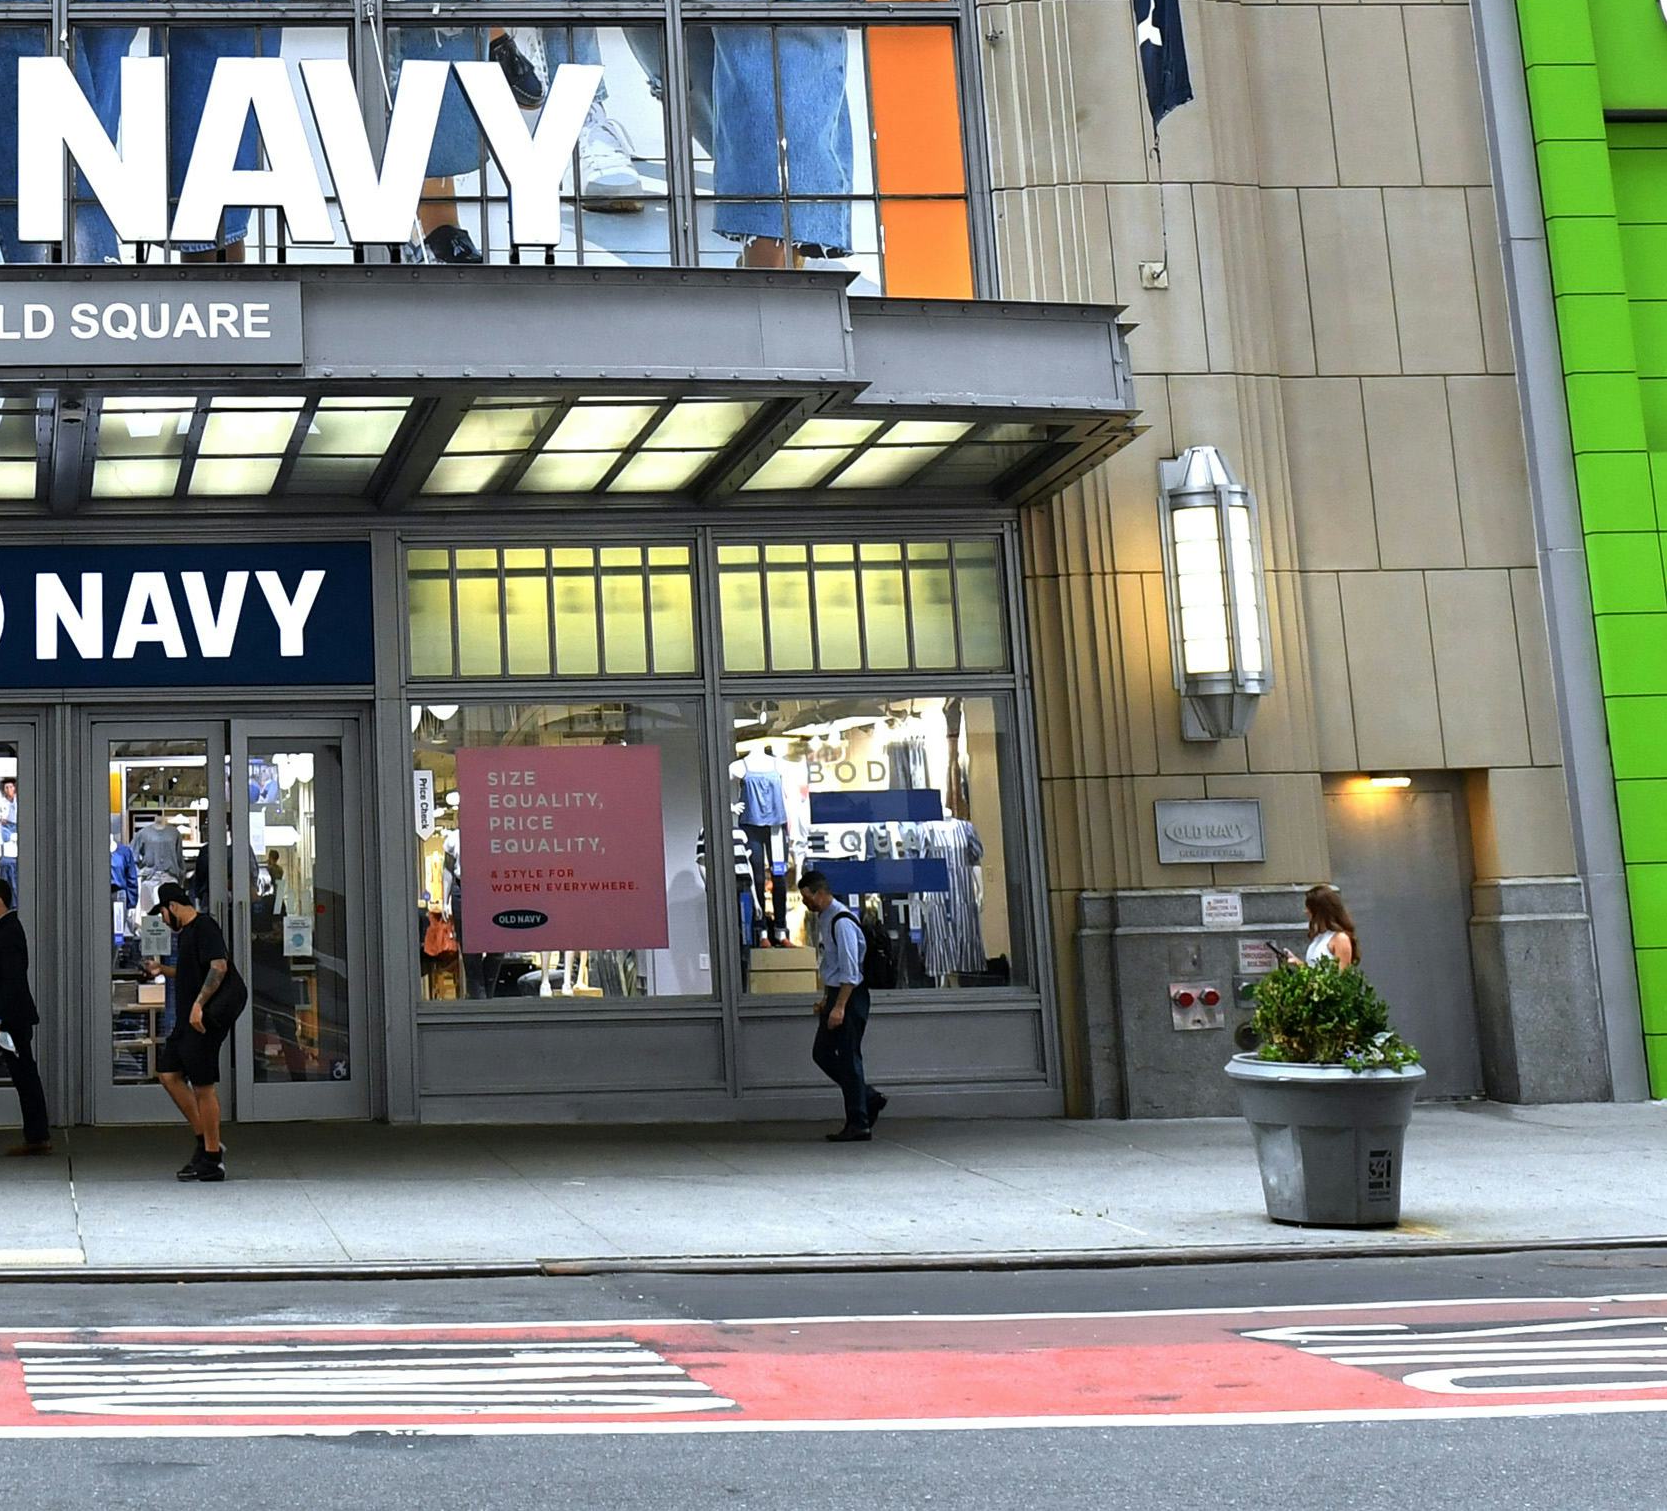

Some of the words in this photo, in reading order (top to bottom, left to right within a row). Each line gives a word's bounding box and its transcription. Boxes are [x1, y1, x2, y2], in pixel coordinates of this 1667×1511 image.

[18, 56, 605, 247] NAVY
[71, 302, 271, 341] SQUARE
[36, 570, 326, 659] NAVY
[487, 771, 536, 786] SIZE
[808, 760, 886, 783] BOD
[419, 778, 428, 800] Price
[488, 792, 604, 809] EQUALITY,
[420, 802, 430, 829] Check
[489, 816, 554, 830] PRICE
[1174, 824, 1201, 839] OLD
[490, 837, 606, 855] EQUALITY,
[504, 869, 544, 879] STYLE
[549, 868, 574, 878] FOR
[491, 883, 541, 893] WOMEN
[546, 881, 639, 891] EVERYWHERE.
[499, 915, 516, 924] OLD
[518, 915, 541, 923] NAVY
